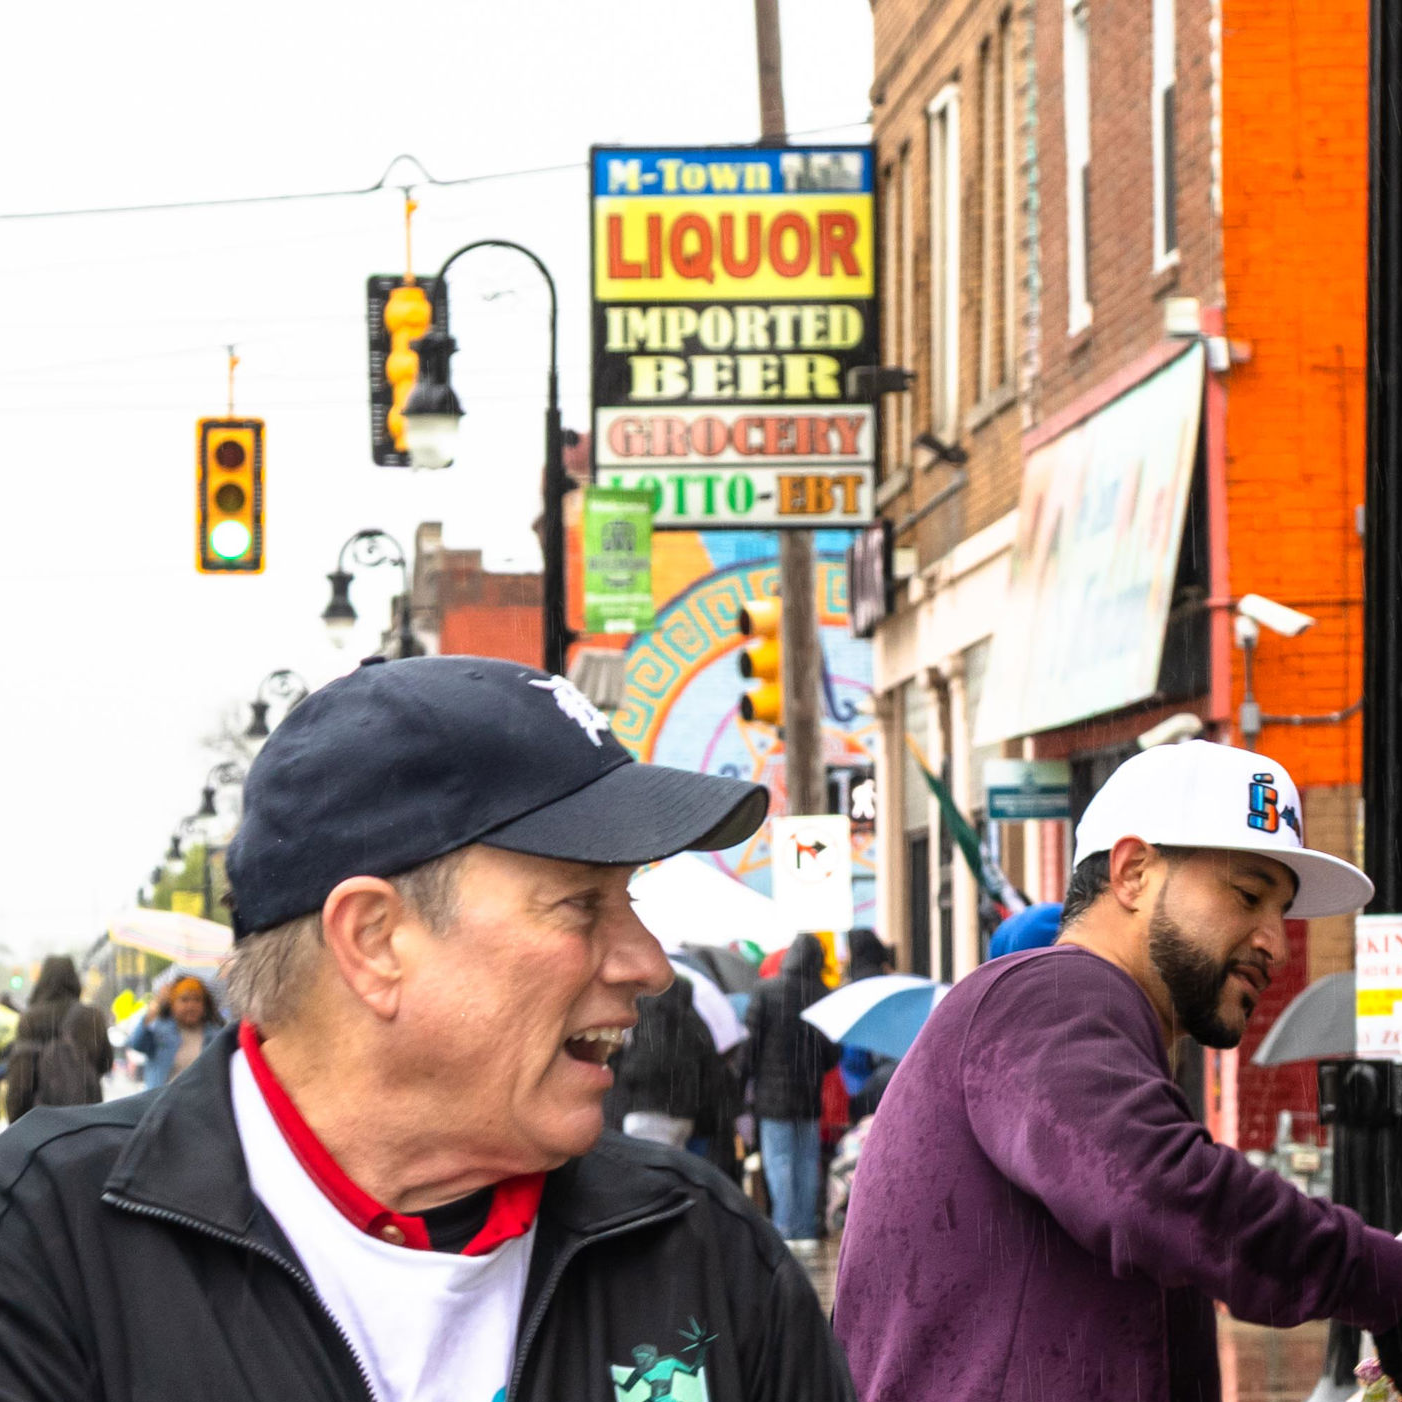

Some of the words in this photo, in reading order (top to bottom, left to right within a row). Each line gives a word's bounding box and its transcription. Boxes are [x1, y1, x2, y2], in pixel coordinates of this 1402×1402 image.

[607, 158, 771, 192] M-Town
[607, 212, 863, 283] LIQUOR
[605, 305, 865, 352] IMPORTED
[629, 354, 842, 399] BEER
[608, 415, 866, 458] GROCERY
